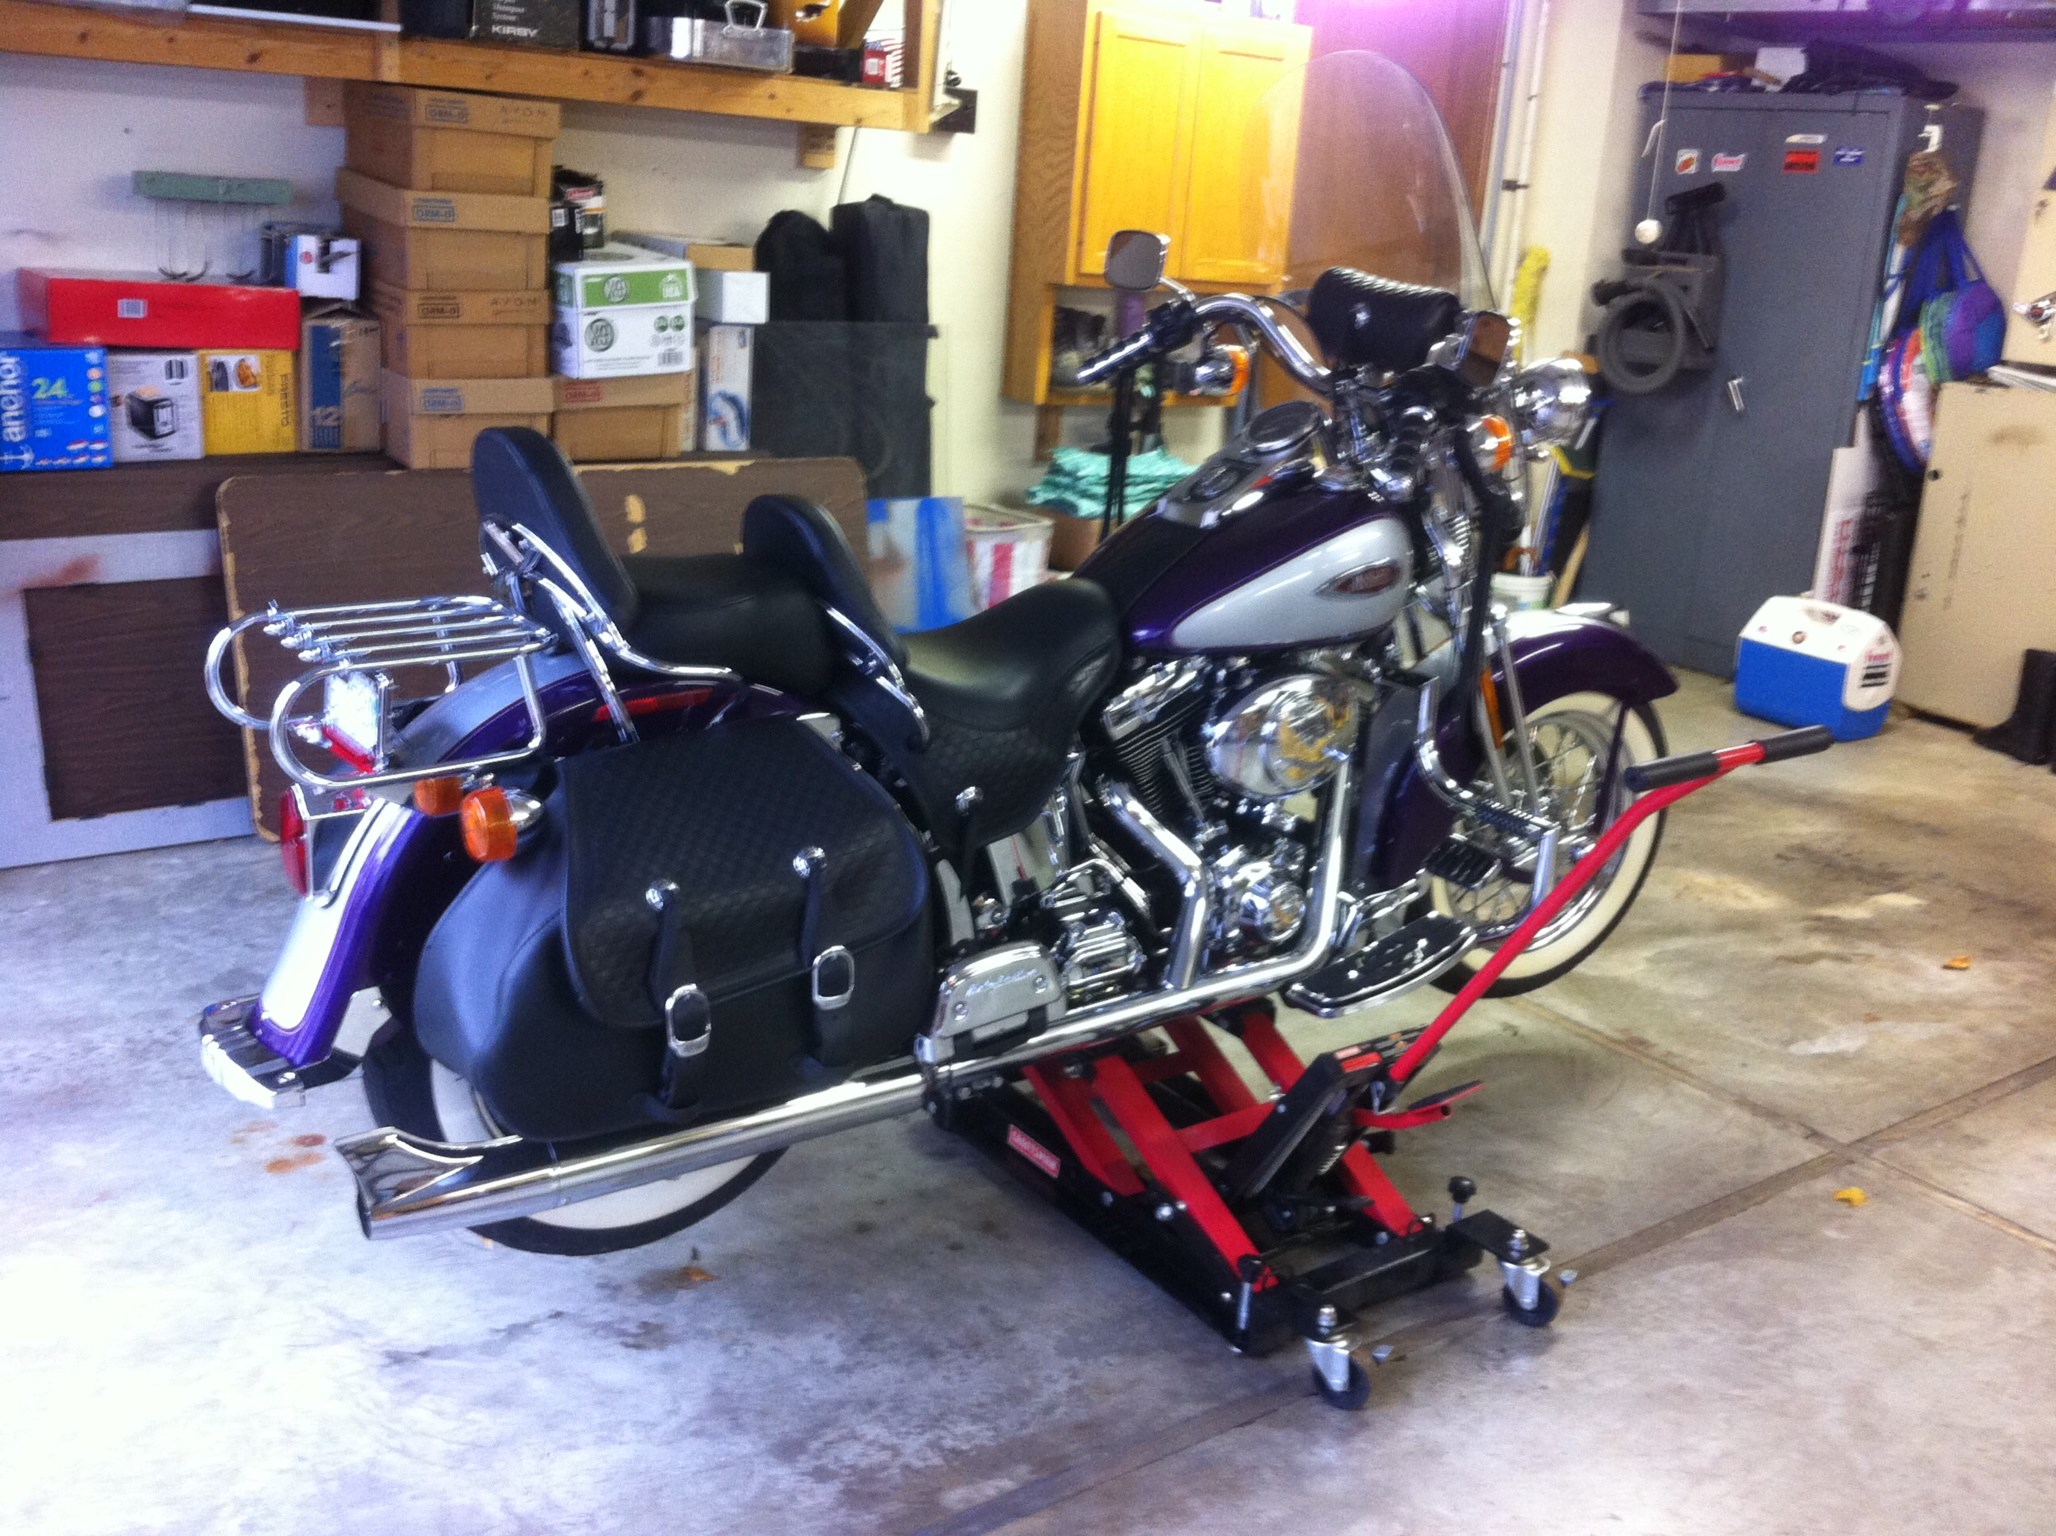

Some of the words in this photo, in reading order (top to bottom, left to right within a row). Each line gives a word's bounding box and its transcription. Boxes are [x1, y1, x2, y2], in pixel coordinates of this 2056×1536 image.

[491, 25, 540, 37] KIRBY
[0, 350, 26, 442] anchor
[32, 377, 69, 399] 24
[312, 406, 342, 427] 12
